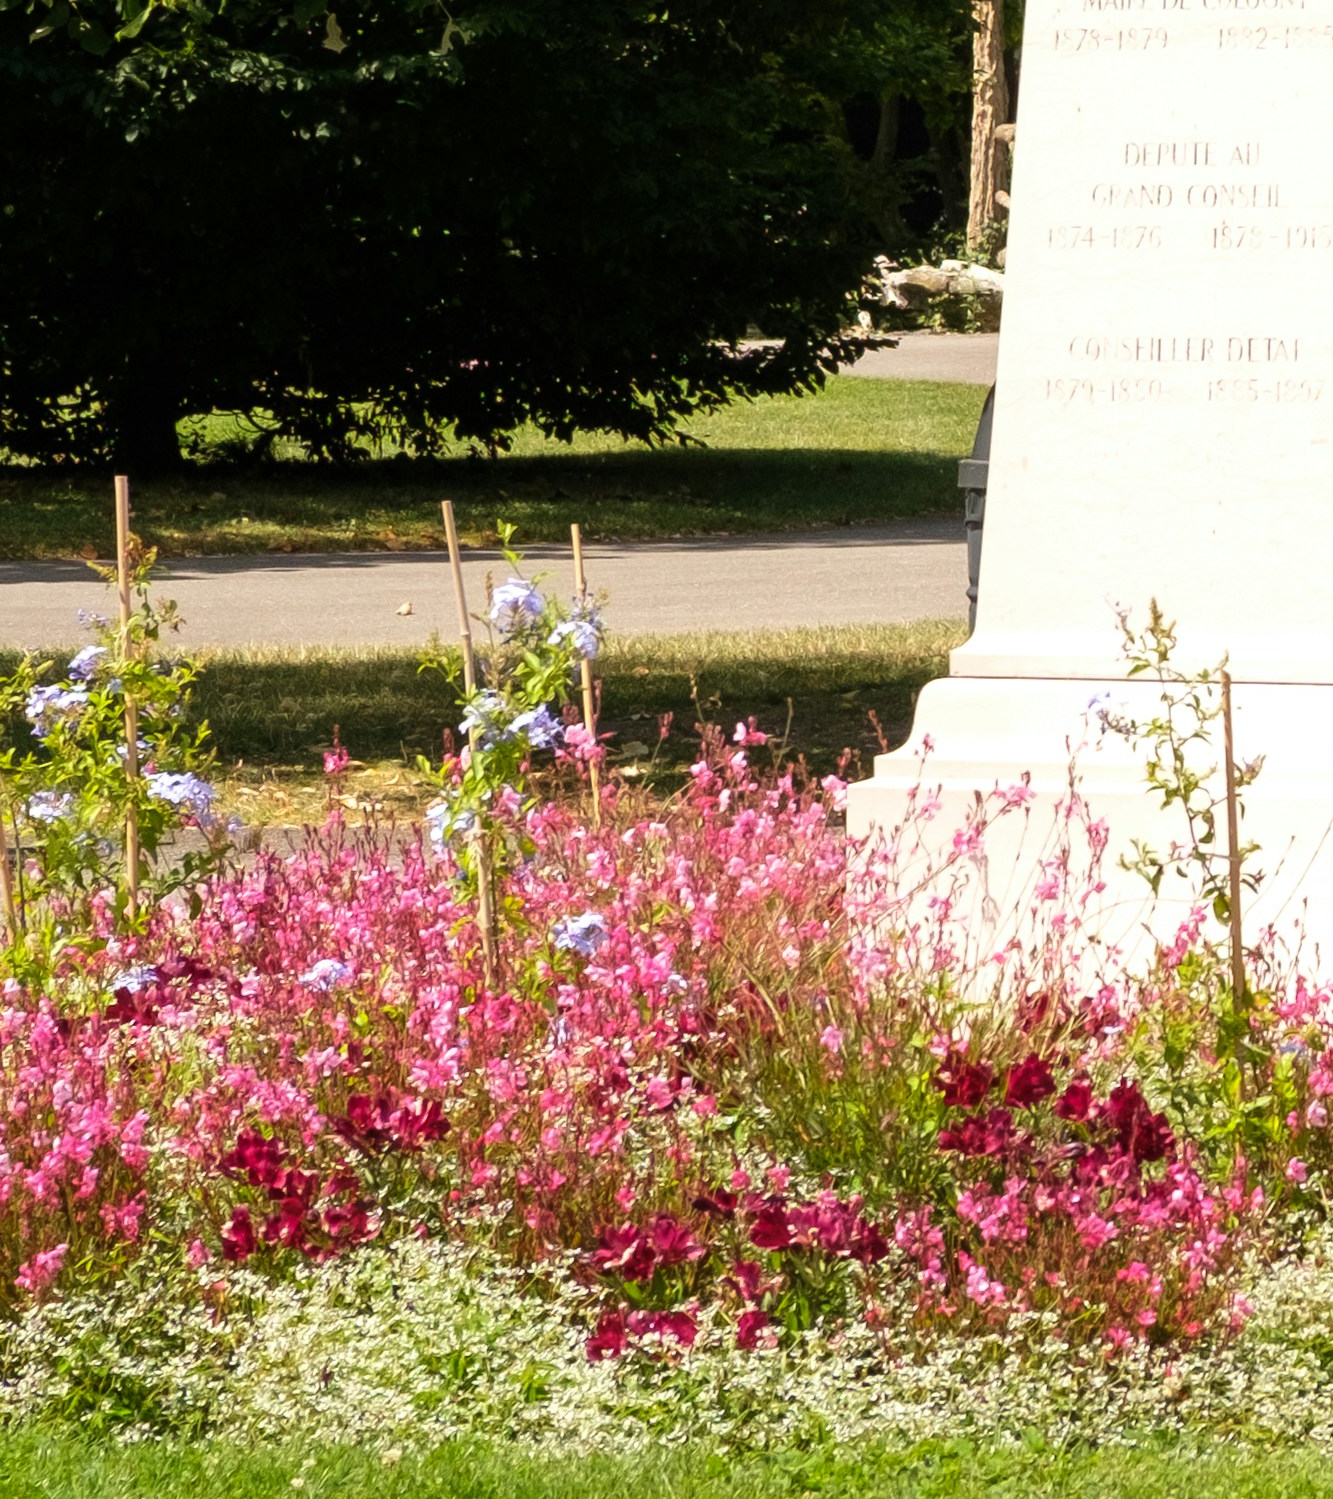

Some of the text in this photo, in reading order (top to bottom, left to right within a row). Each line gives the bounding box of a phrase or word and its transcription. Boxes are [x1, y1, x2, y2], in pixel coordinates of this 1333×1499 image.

[1228, 141, 1260, 167] AU
[1091, 183, 1287, 209] GRAND CONSEIL
[1068, 336, 1215, 362] CONSEILLER
